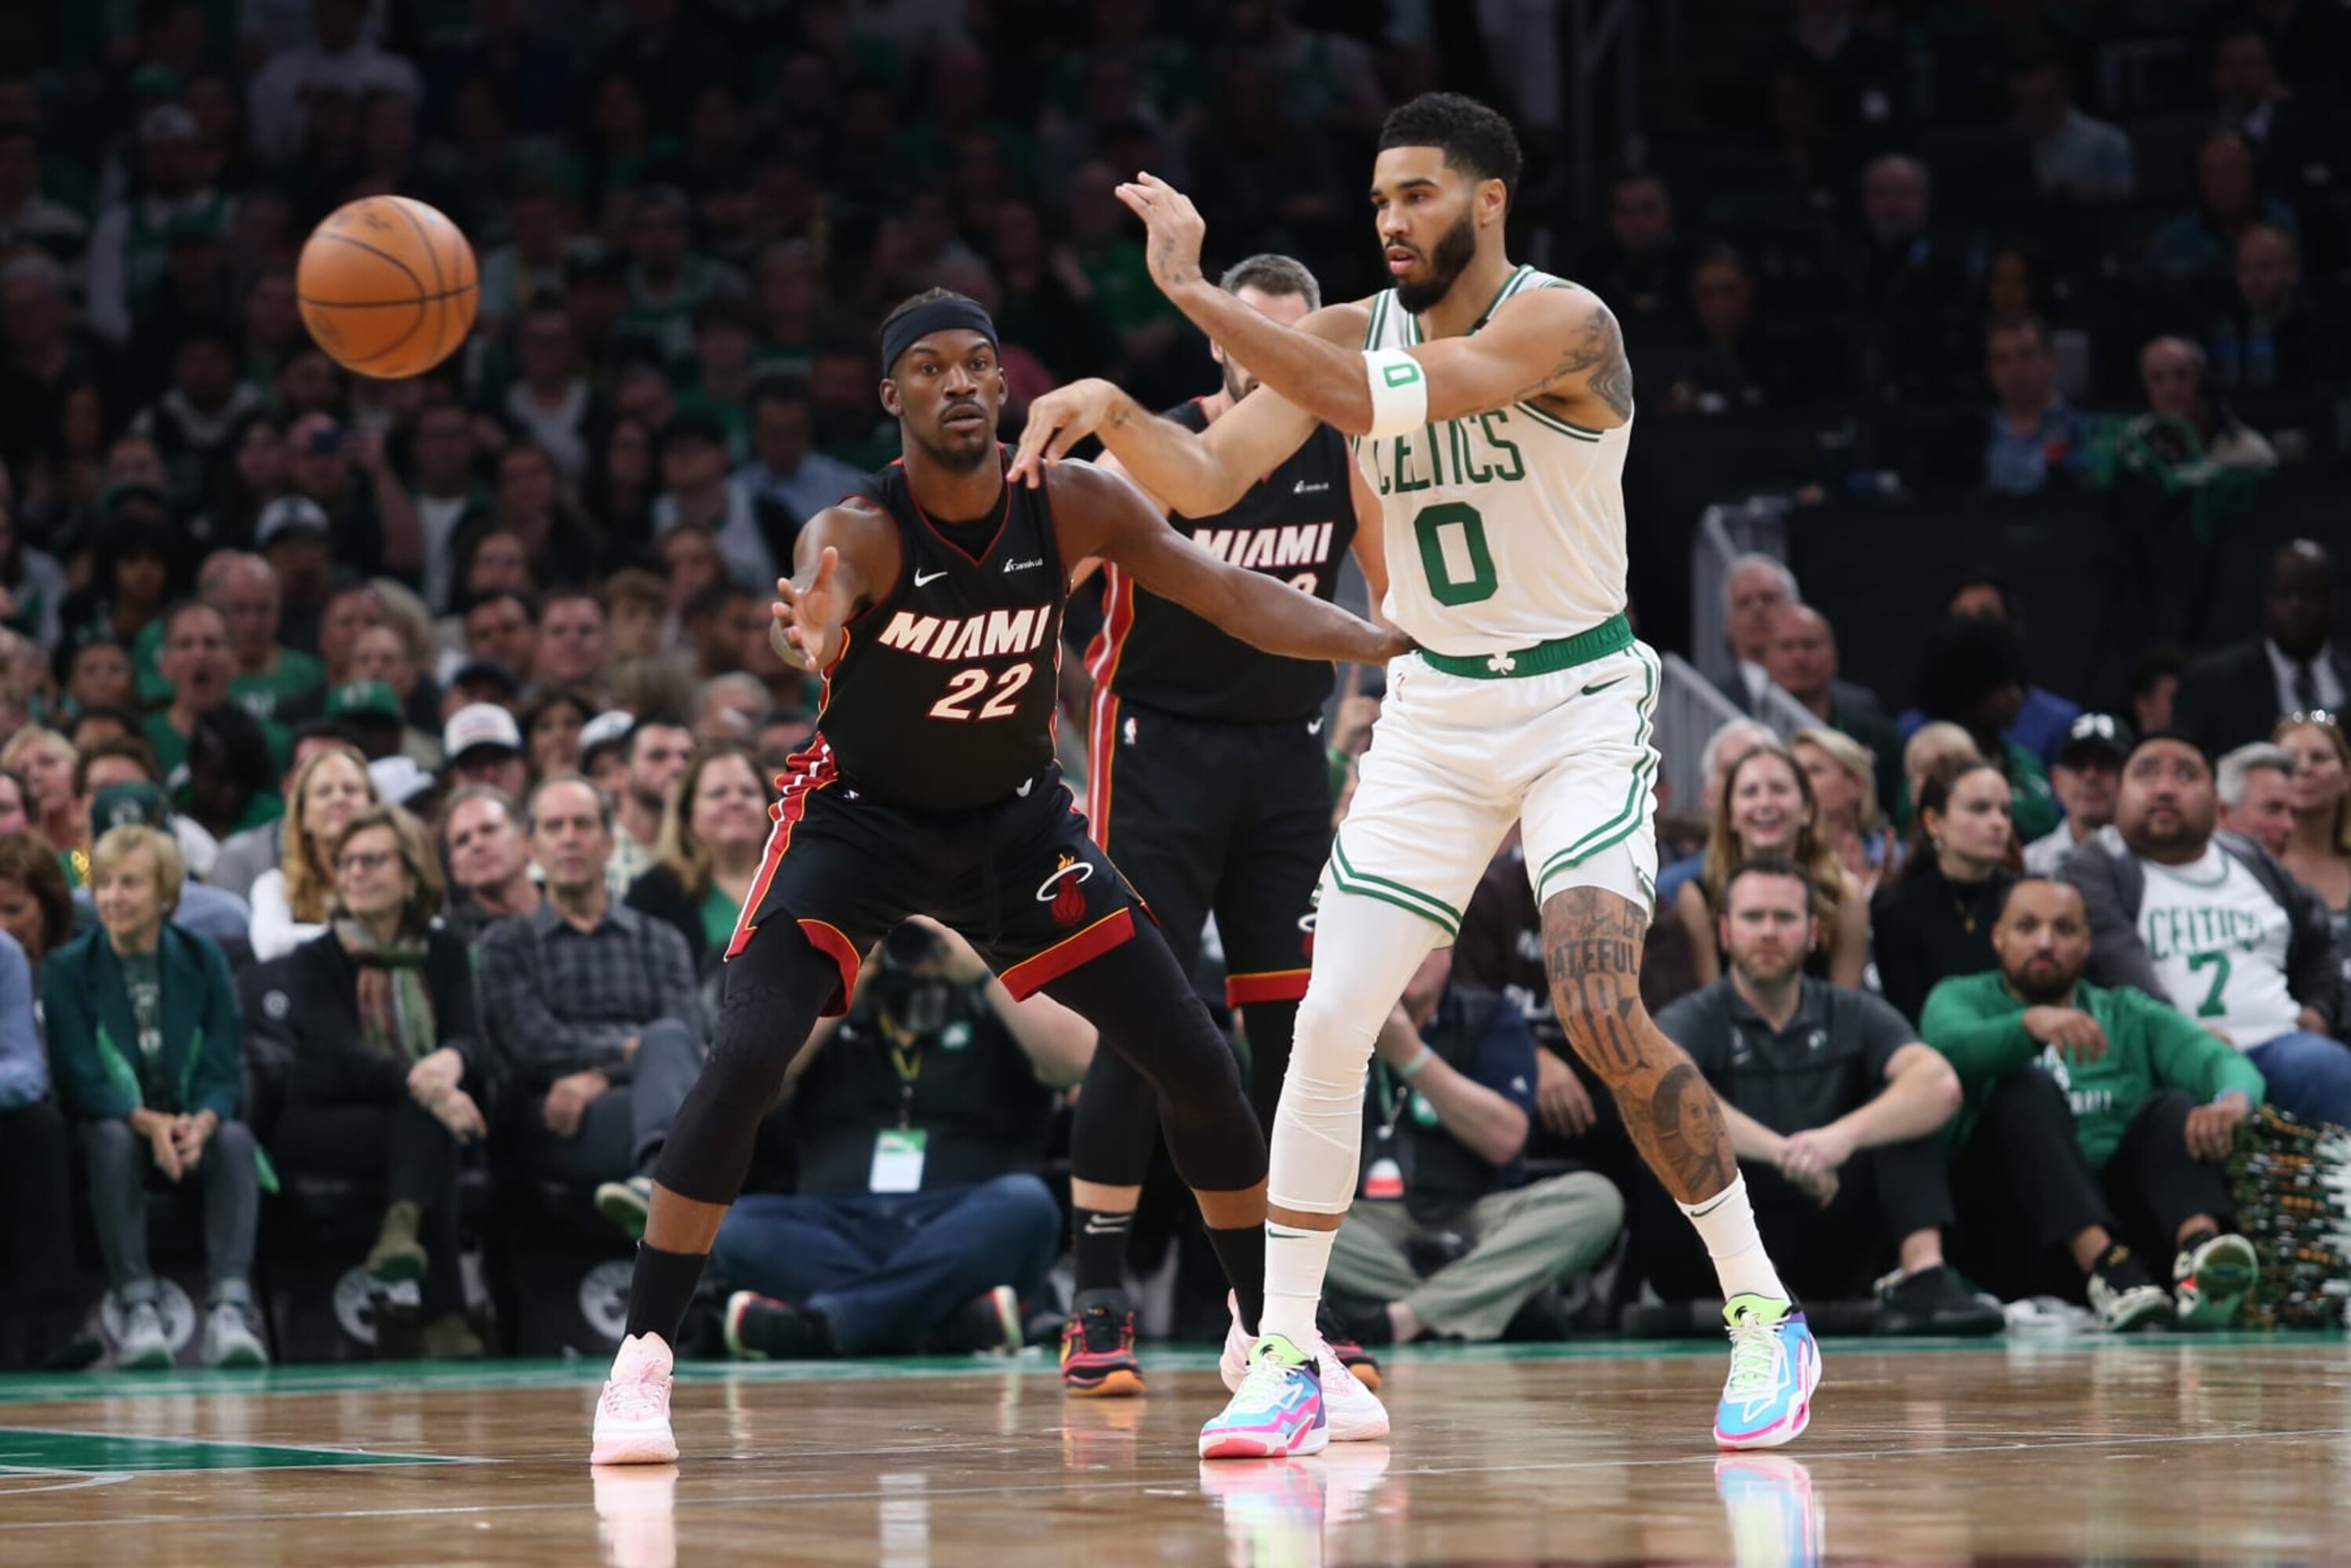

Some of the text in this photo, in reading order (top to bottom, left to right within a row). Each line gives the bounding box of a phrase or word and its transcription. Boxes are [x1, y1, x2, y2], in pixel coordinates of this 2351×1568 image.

[1192, 521, 1334, 568] MIAMI
[1414, 502, 1499, 607] 0
[877, 604, 1052, 661] MIAMI
[926, 662, 1034, 722] 22
[2188, 950, 2230, 1017] 7
